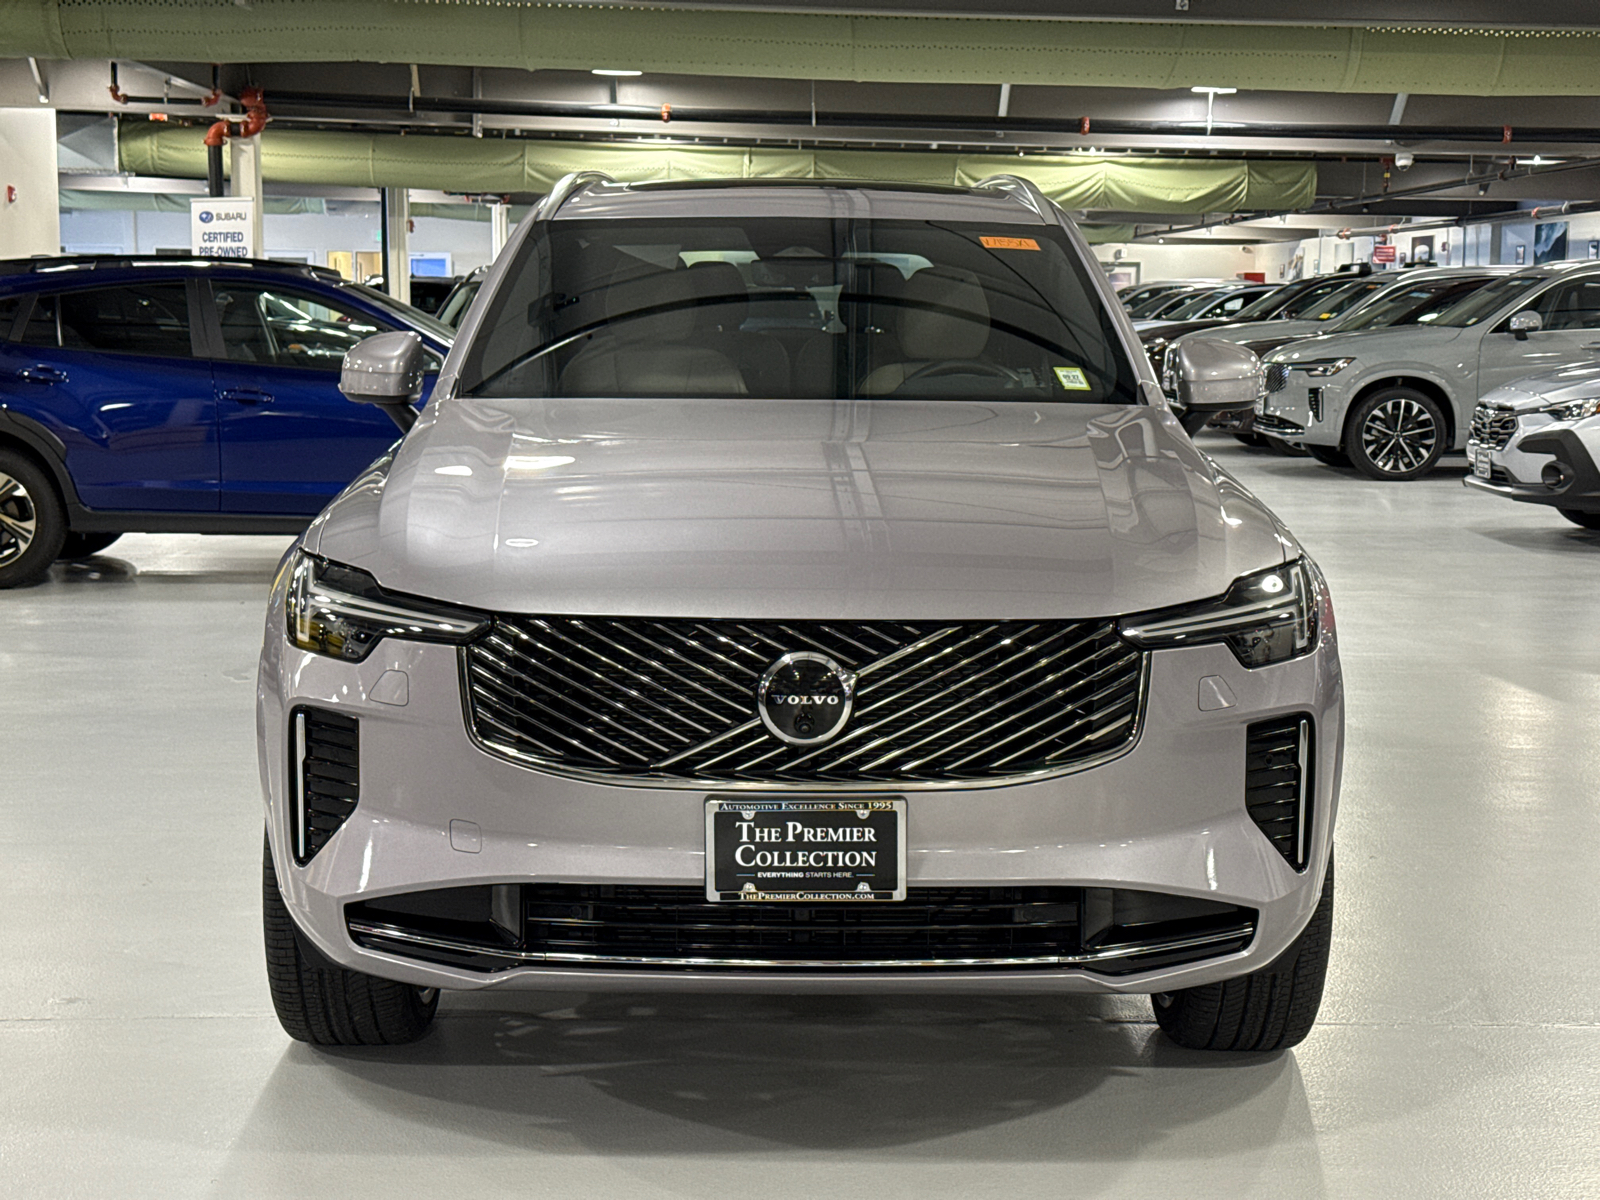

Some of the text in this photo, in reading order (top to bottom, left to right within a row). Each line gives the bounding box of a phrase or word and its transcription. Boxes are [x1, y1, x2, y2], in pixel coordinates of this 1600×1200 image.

[216, 212, 247, 221] SUBARU
[202, 231, 244, 243] CERTIFIED
[199, 246, 248, 258] PRE-OWNED
[771, 695, 839, 705] VOLVO
[720, 802, 779, 811] AUTOMOTIVE
[782, 802, 836, 811] EXCELLENCE
[838, 802, 865, 810] SINCE
[735, 821, 877, 842] THE PREMIER
[735, 844, 878, 867] COLLECTION
